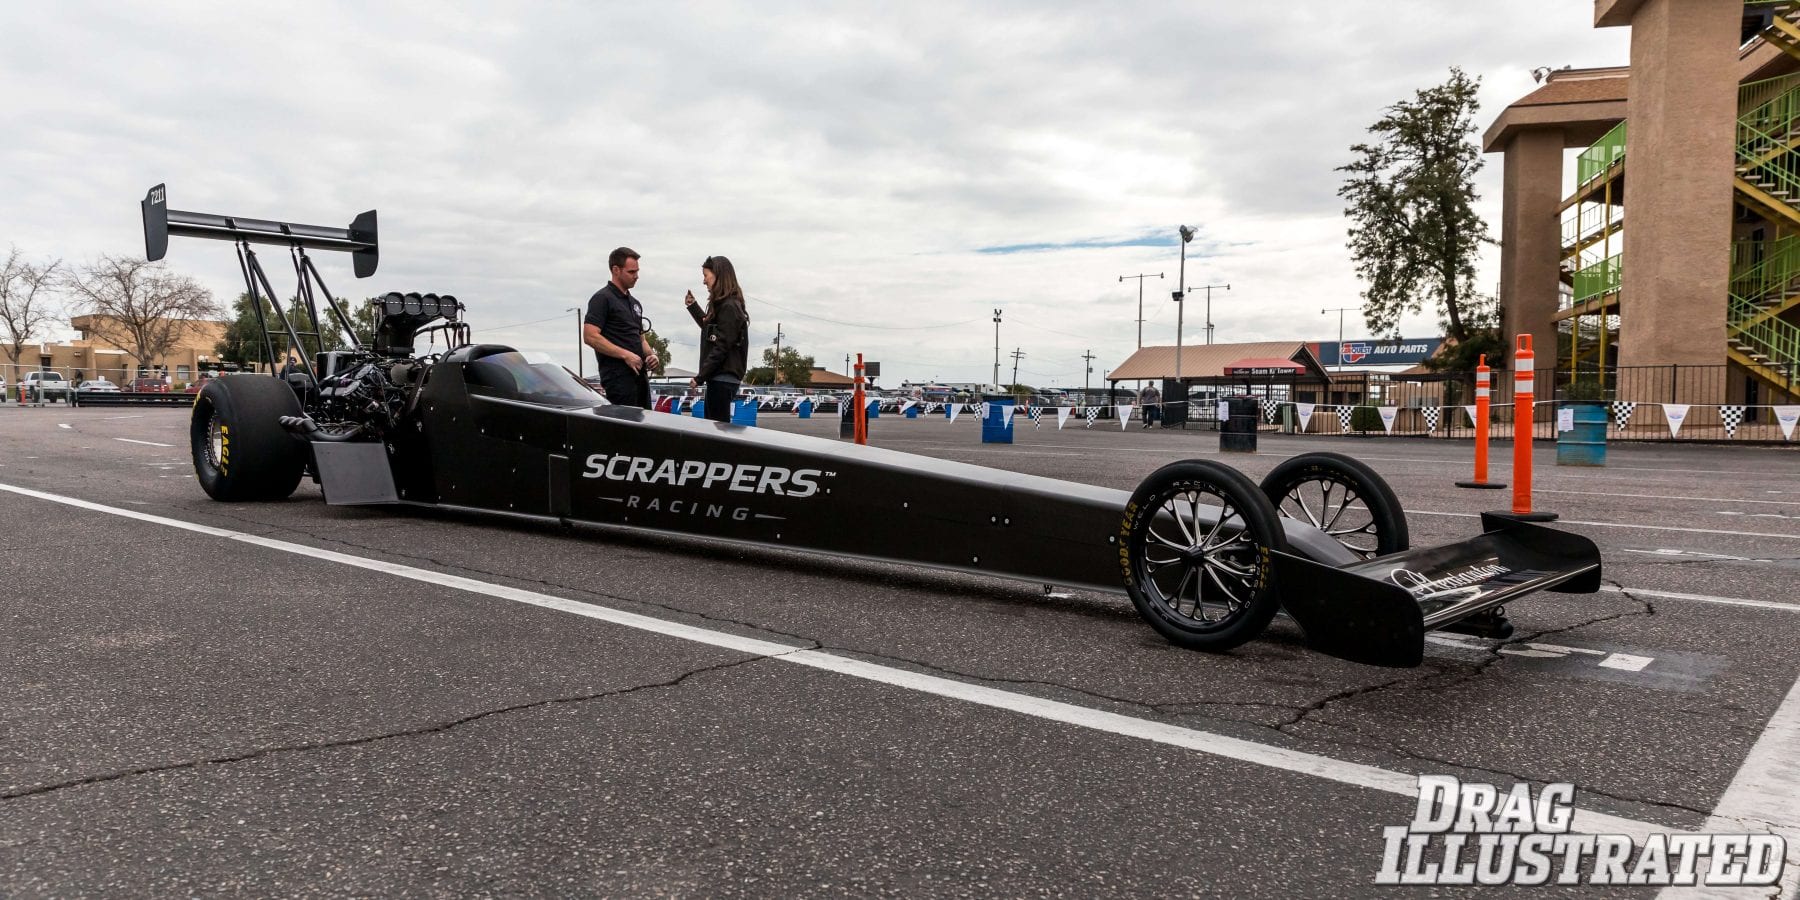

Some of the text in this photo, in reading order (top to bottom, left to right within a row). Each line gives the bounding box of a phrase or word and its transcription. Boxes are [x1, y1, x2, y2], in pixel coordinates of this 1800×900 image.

[151, 187, 164, 205] 7211
[1373, 345, 1397, 354] AUTO
[1399, 344, 1428, 354] PARTS
[221, 425, 230, 477] EAGLE
[583, 453, 822, 498] SCRAPPERS
[627, 495, 749, 521] RACING
